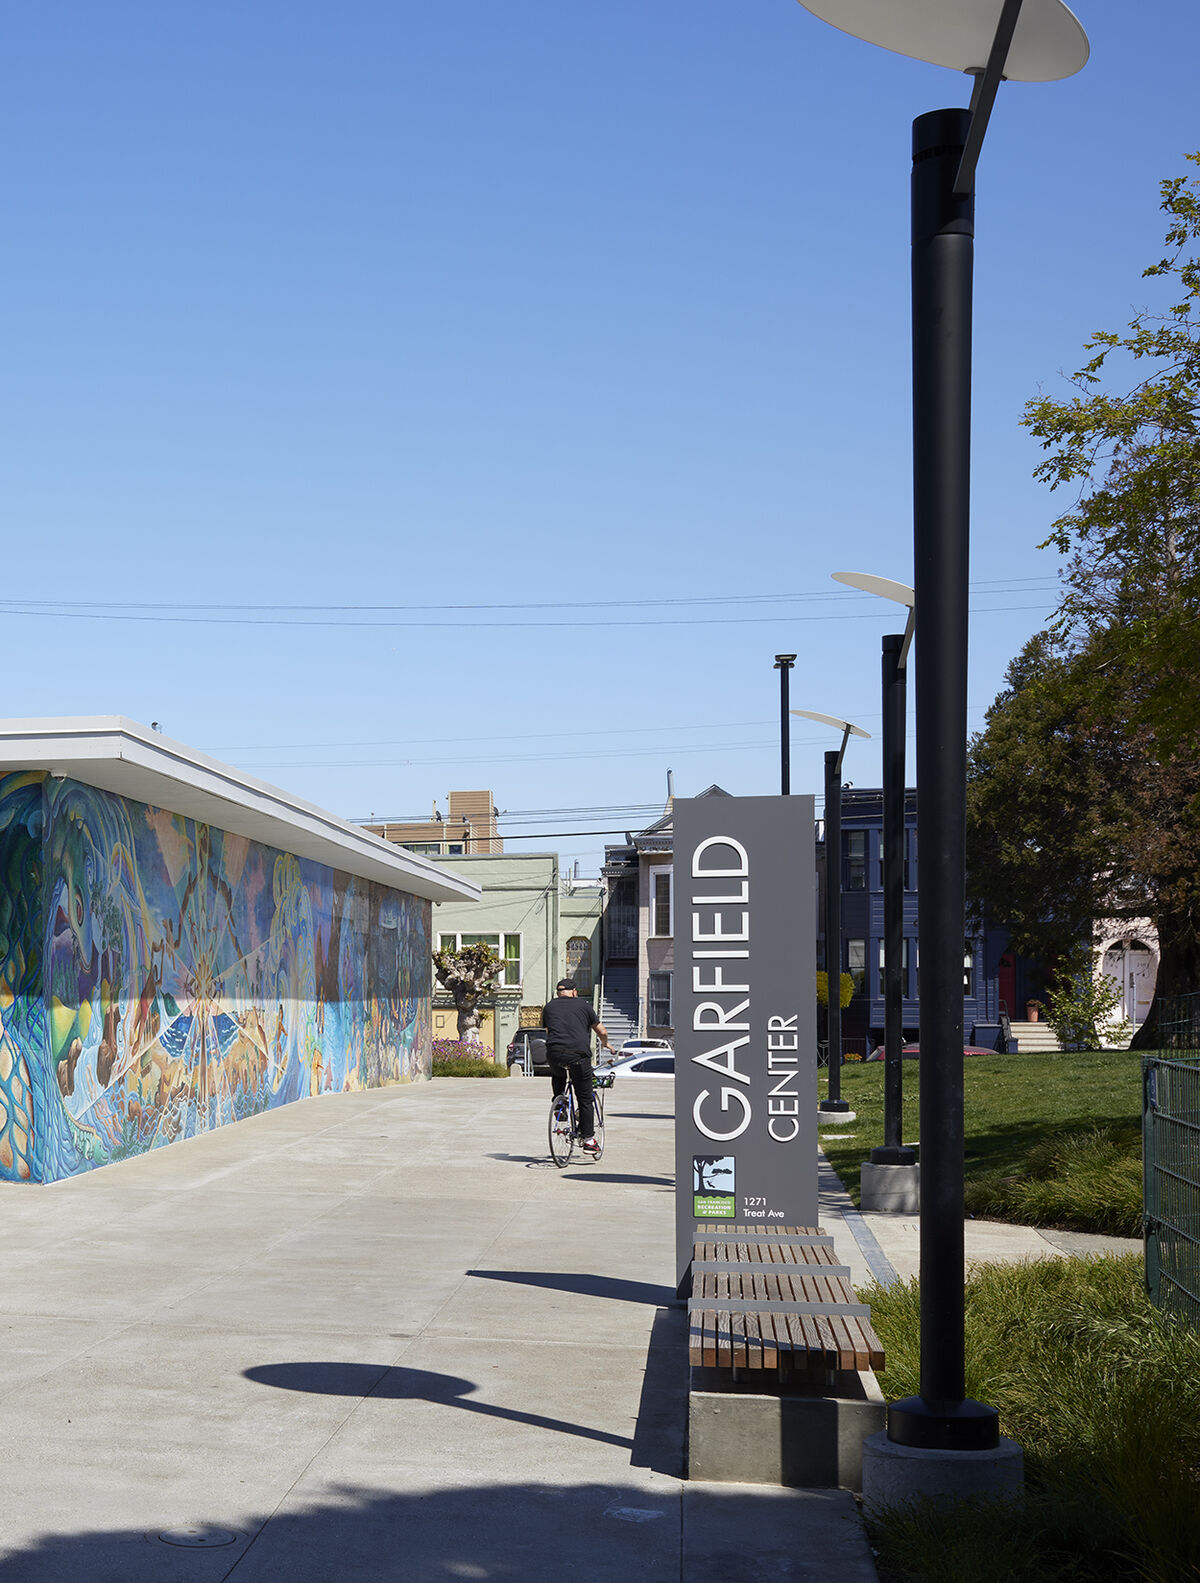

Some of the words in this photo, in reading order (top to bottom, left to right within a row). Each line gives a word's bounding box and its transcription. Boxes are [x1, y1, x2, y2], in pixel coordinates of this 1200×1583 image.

[691, 835, 752, 1142] GARFIELD
[767, 1013, 800, 1143] CENTER
[743, 1208, 766, 1217] Treat
[768, 1209, 785, 1218] Ave
[744, 1197, 767, 1206] 1271
